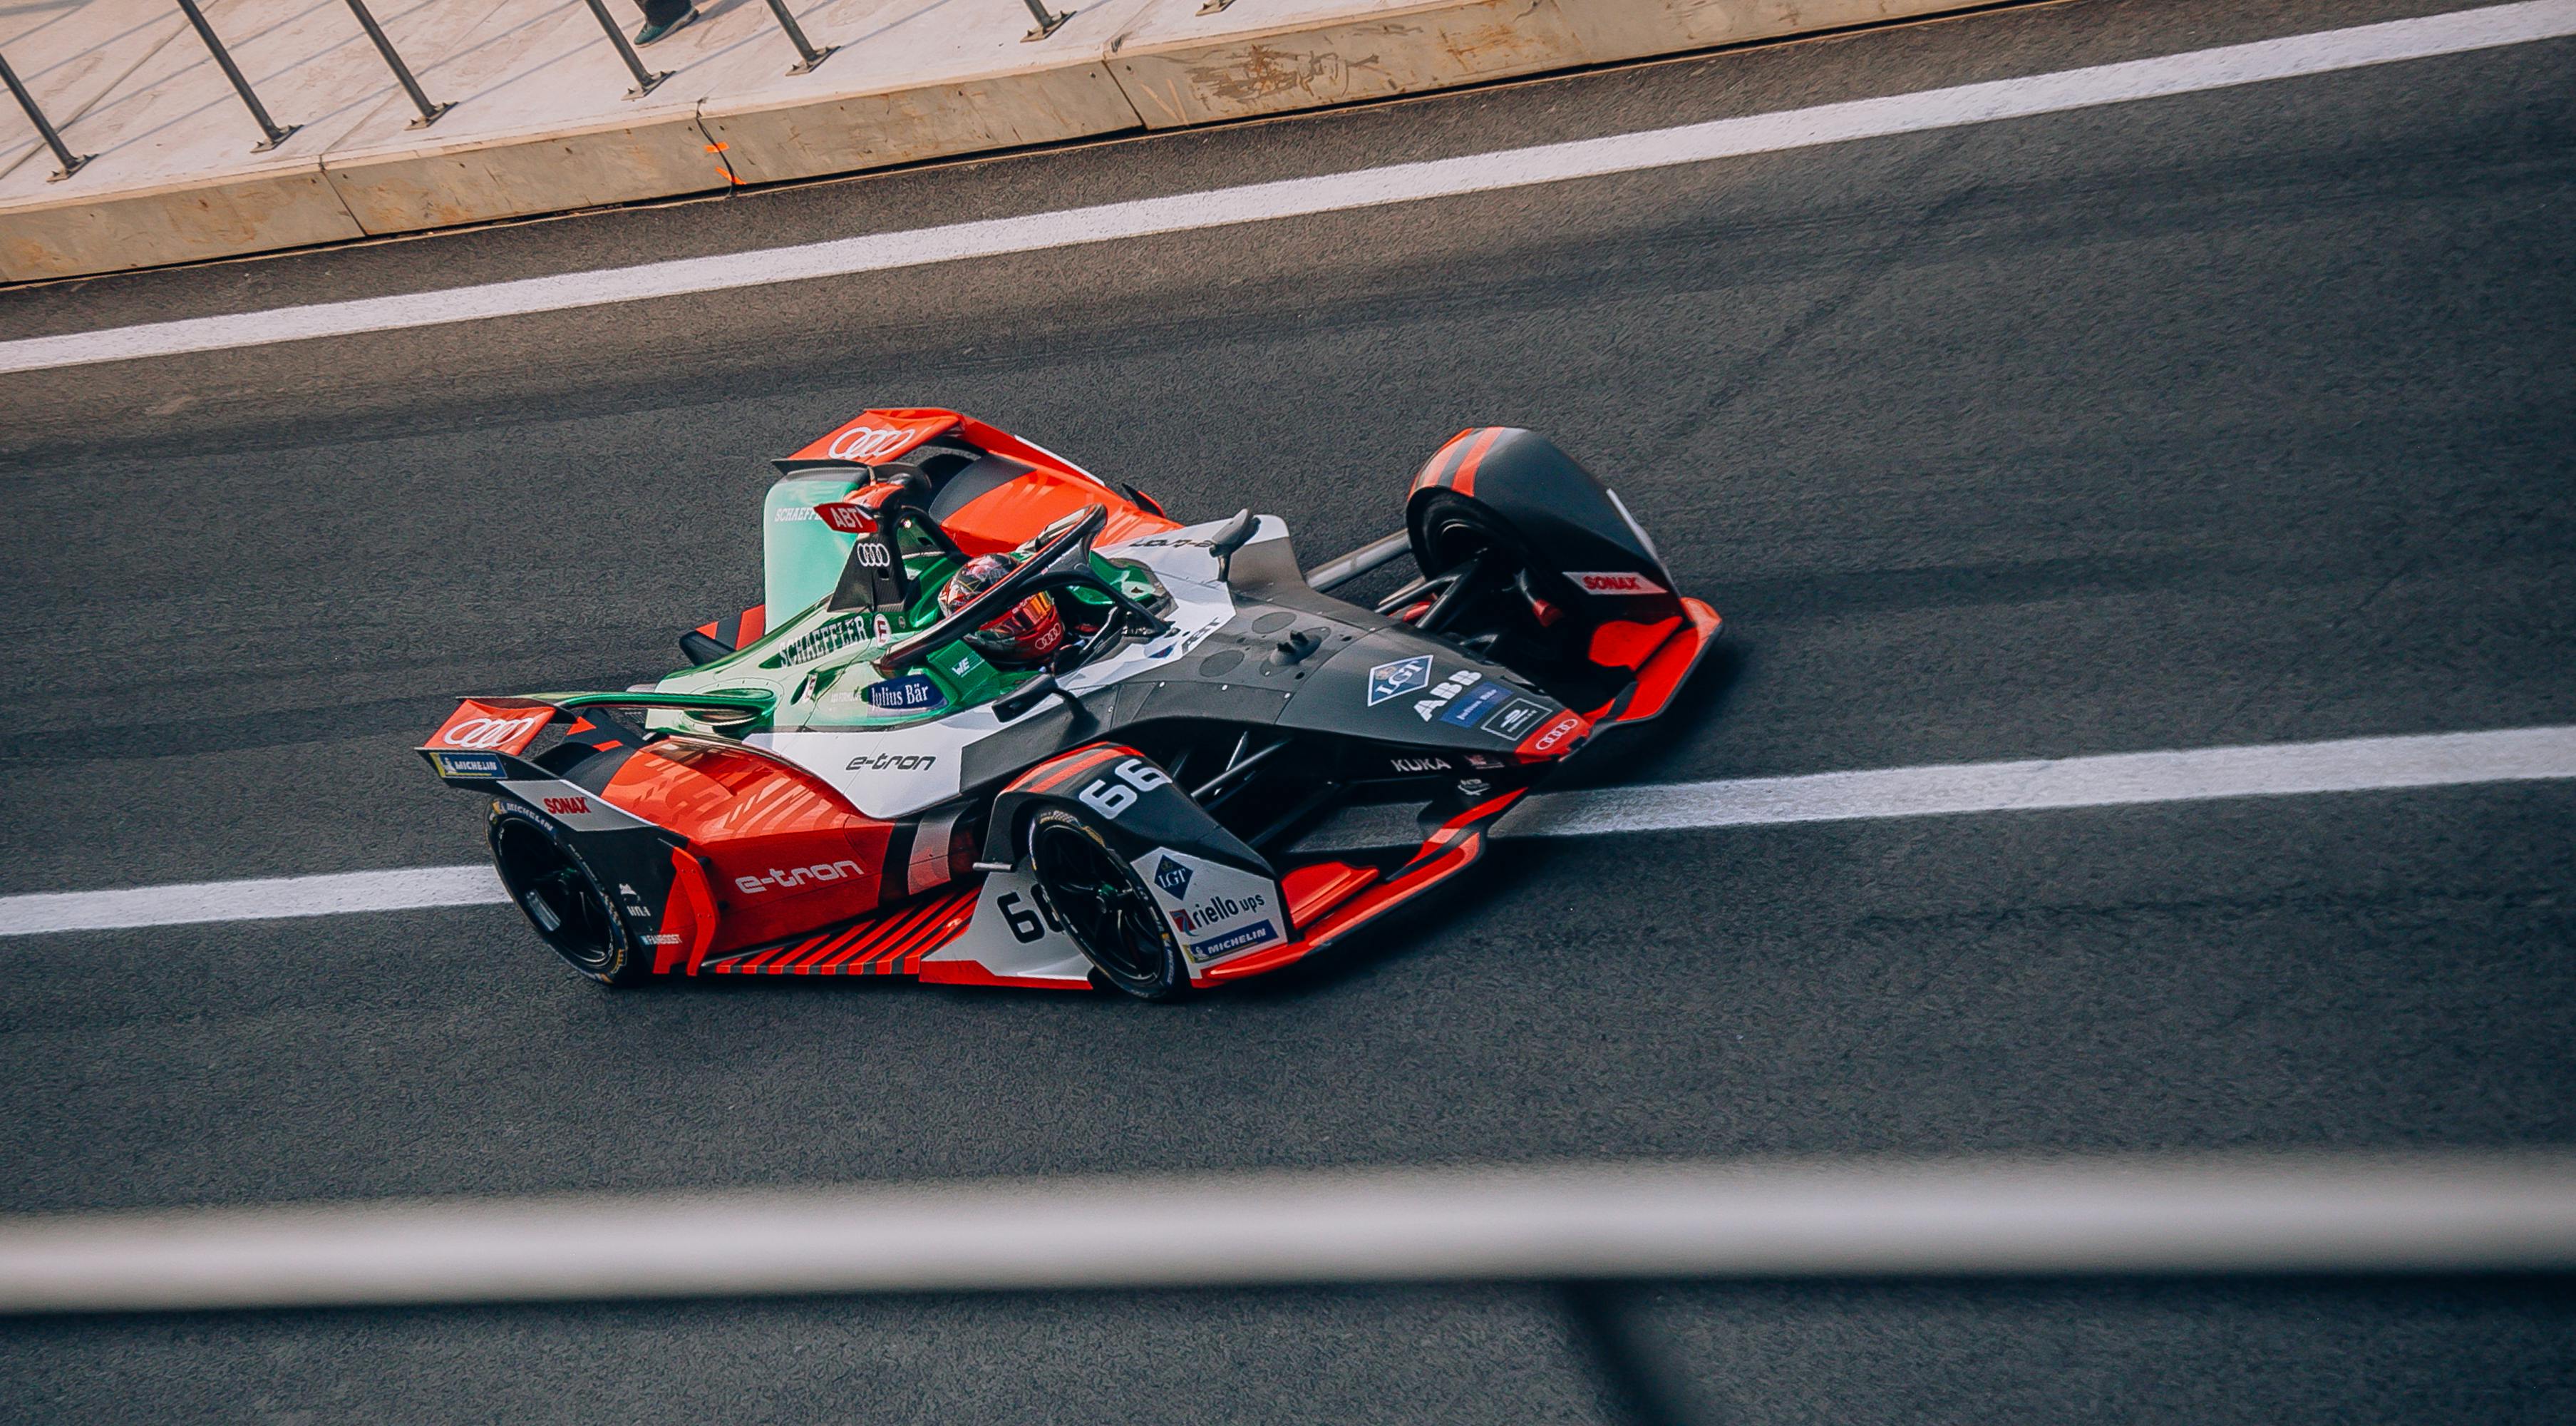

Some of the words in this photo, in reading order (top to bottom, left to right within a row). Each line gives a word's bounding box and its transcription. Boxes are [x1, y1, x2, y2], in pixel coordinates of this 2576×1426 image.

[830, 507, 863, 528] ABT
[1583, 575, 1642, 590] SONAX
[778, 615, 867, 669] SCHAEFFLER
[1374, 660, 1424, 695] LGT
[871, 687, 904, 711] Julius
[905, 683, 929, 705] Bär
[1413, 670, 1483, 722] ABB
[454, 761, 498, 771] MICHELIN
[846, 752, 937, 771] e-tron
[1391, 758, 1452, 772] KUKA
[1078, 758, 1173, 820] 66
[506, 802, 553, 832] MICHELIN
[543, 796, 592, 814] SONAX
[735, 859, 865, 894] e-tron
[1158, 868, 1186, 888] LGT
[1192, 896, 1239, 928] riello
[1239, 894, 1265, 913] ups
[1207, 928, 1267, 954] MICHELIN
